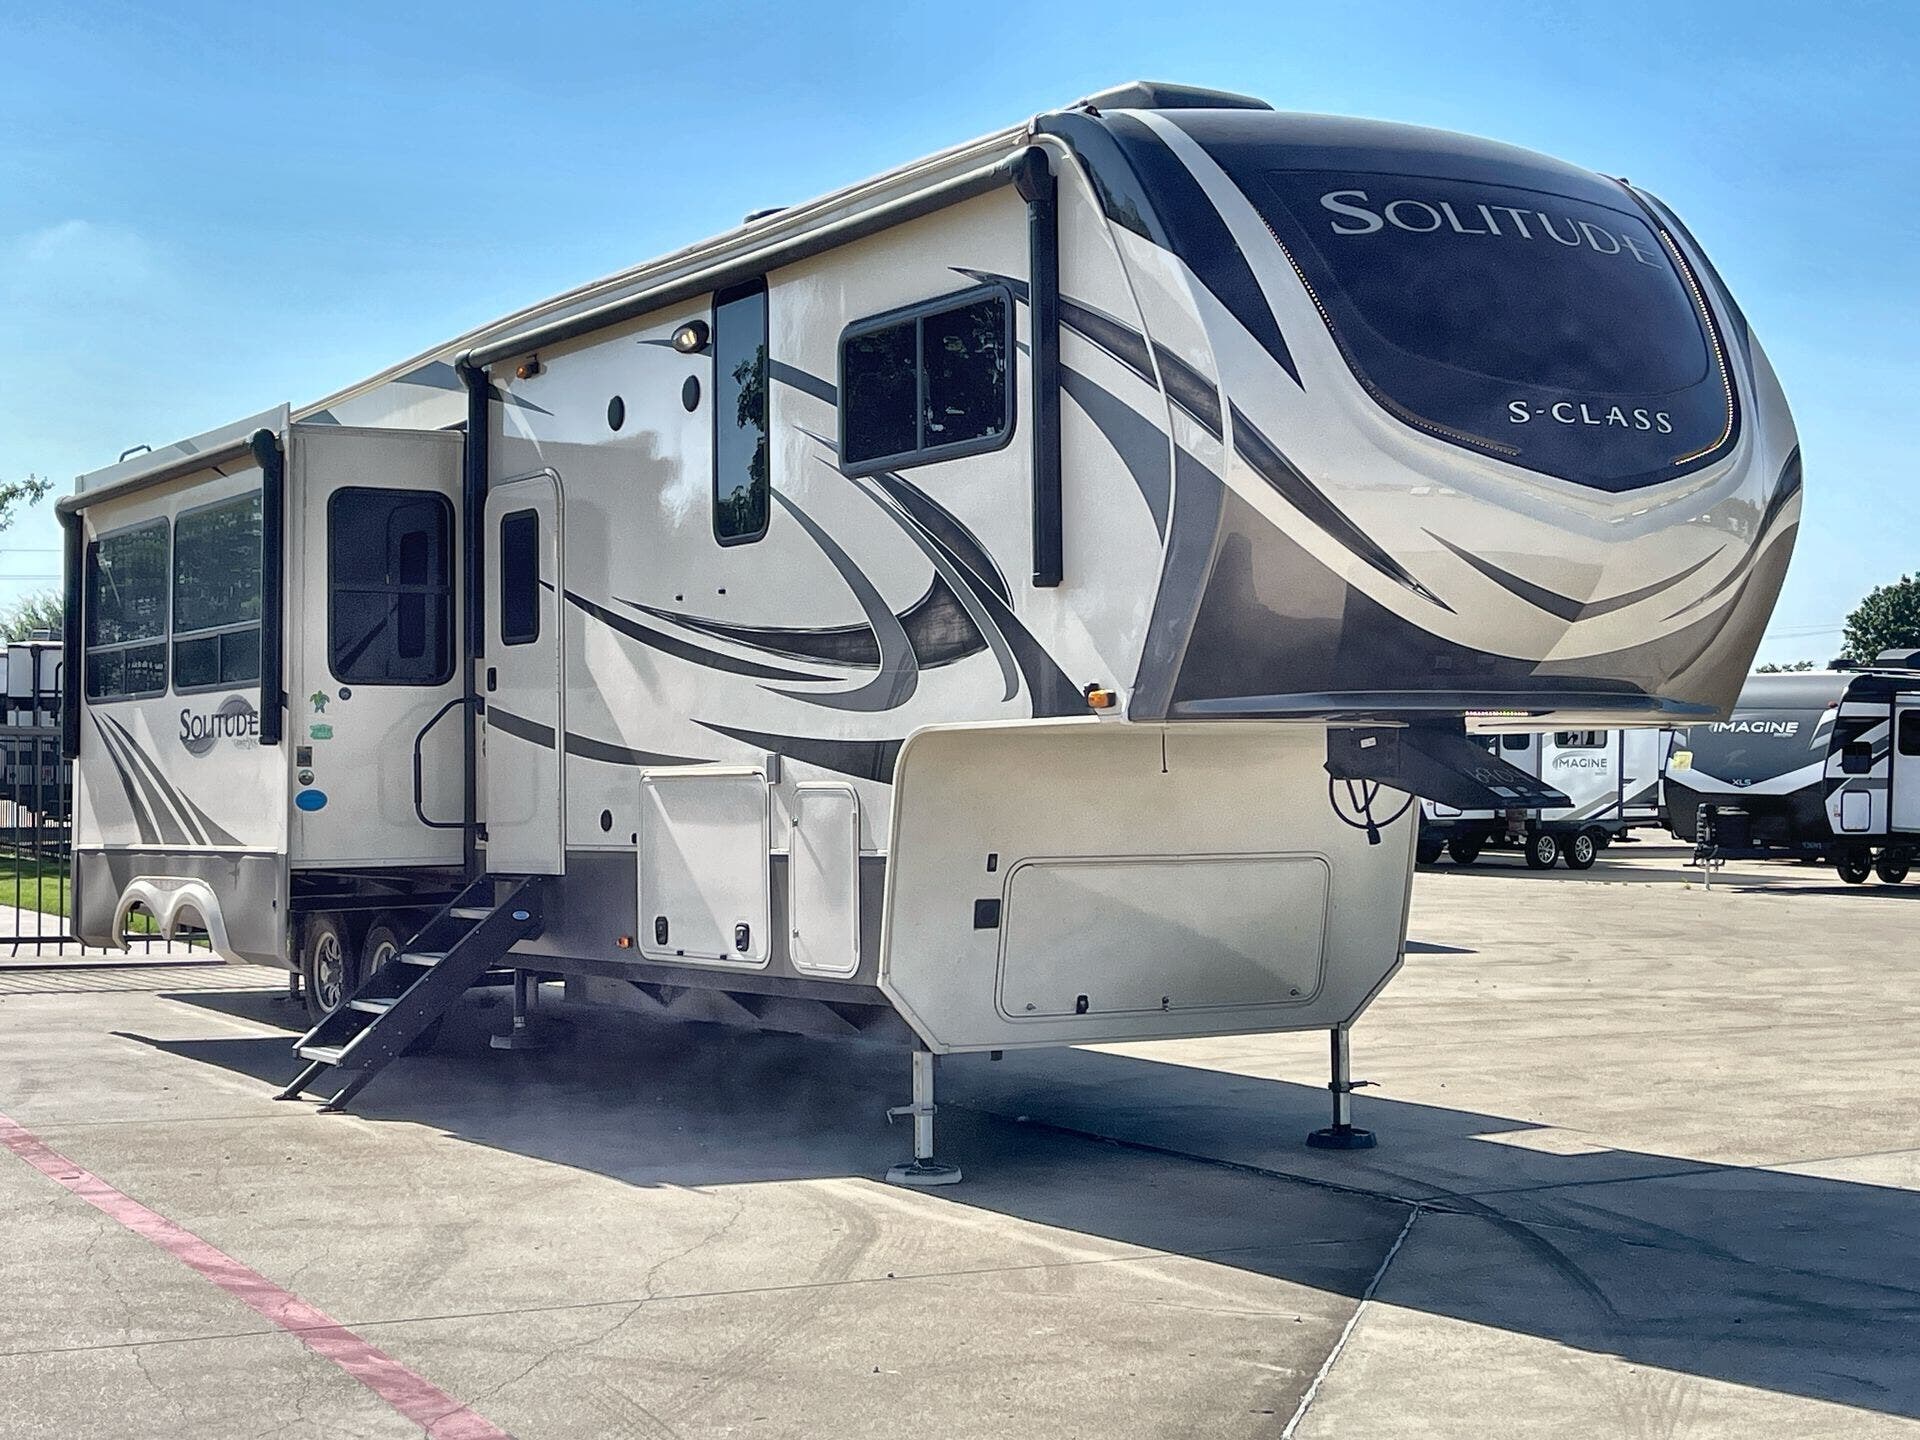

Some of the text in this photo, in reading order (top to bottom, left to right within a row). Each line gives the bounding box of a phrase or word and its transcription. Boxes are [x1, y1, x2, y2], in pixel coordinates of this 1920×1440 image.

[1319, 190, 1663, 270] SOLITUDE
[1508, 400, 1673, 434] S-CLASS
[179, 708, 259, 741] SOLITUDE
[1713, 721, 1799, 733] IMAGINE
[1556, 758, 1608, 768] IMAGINE
[1732, 778, 1751, 786] XLS
